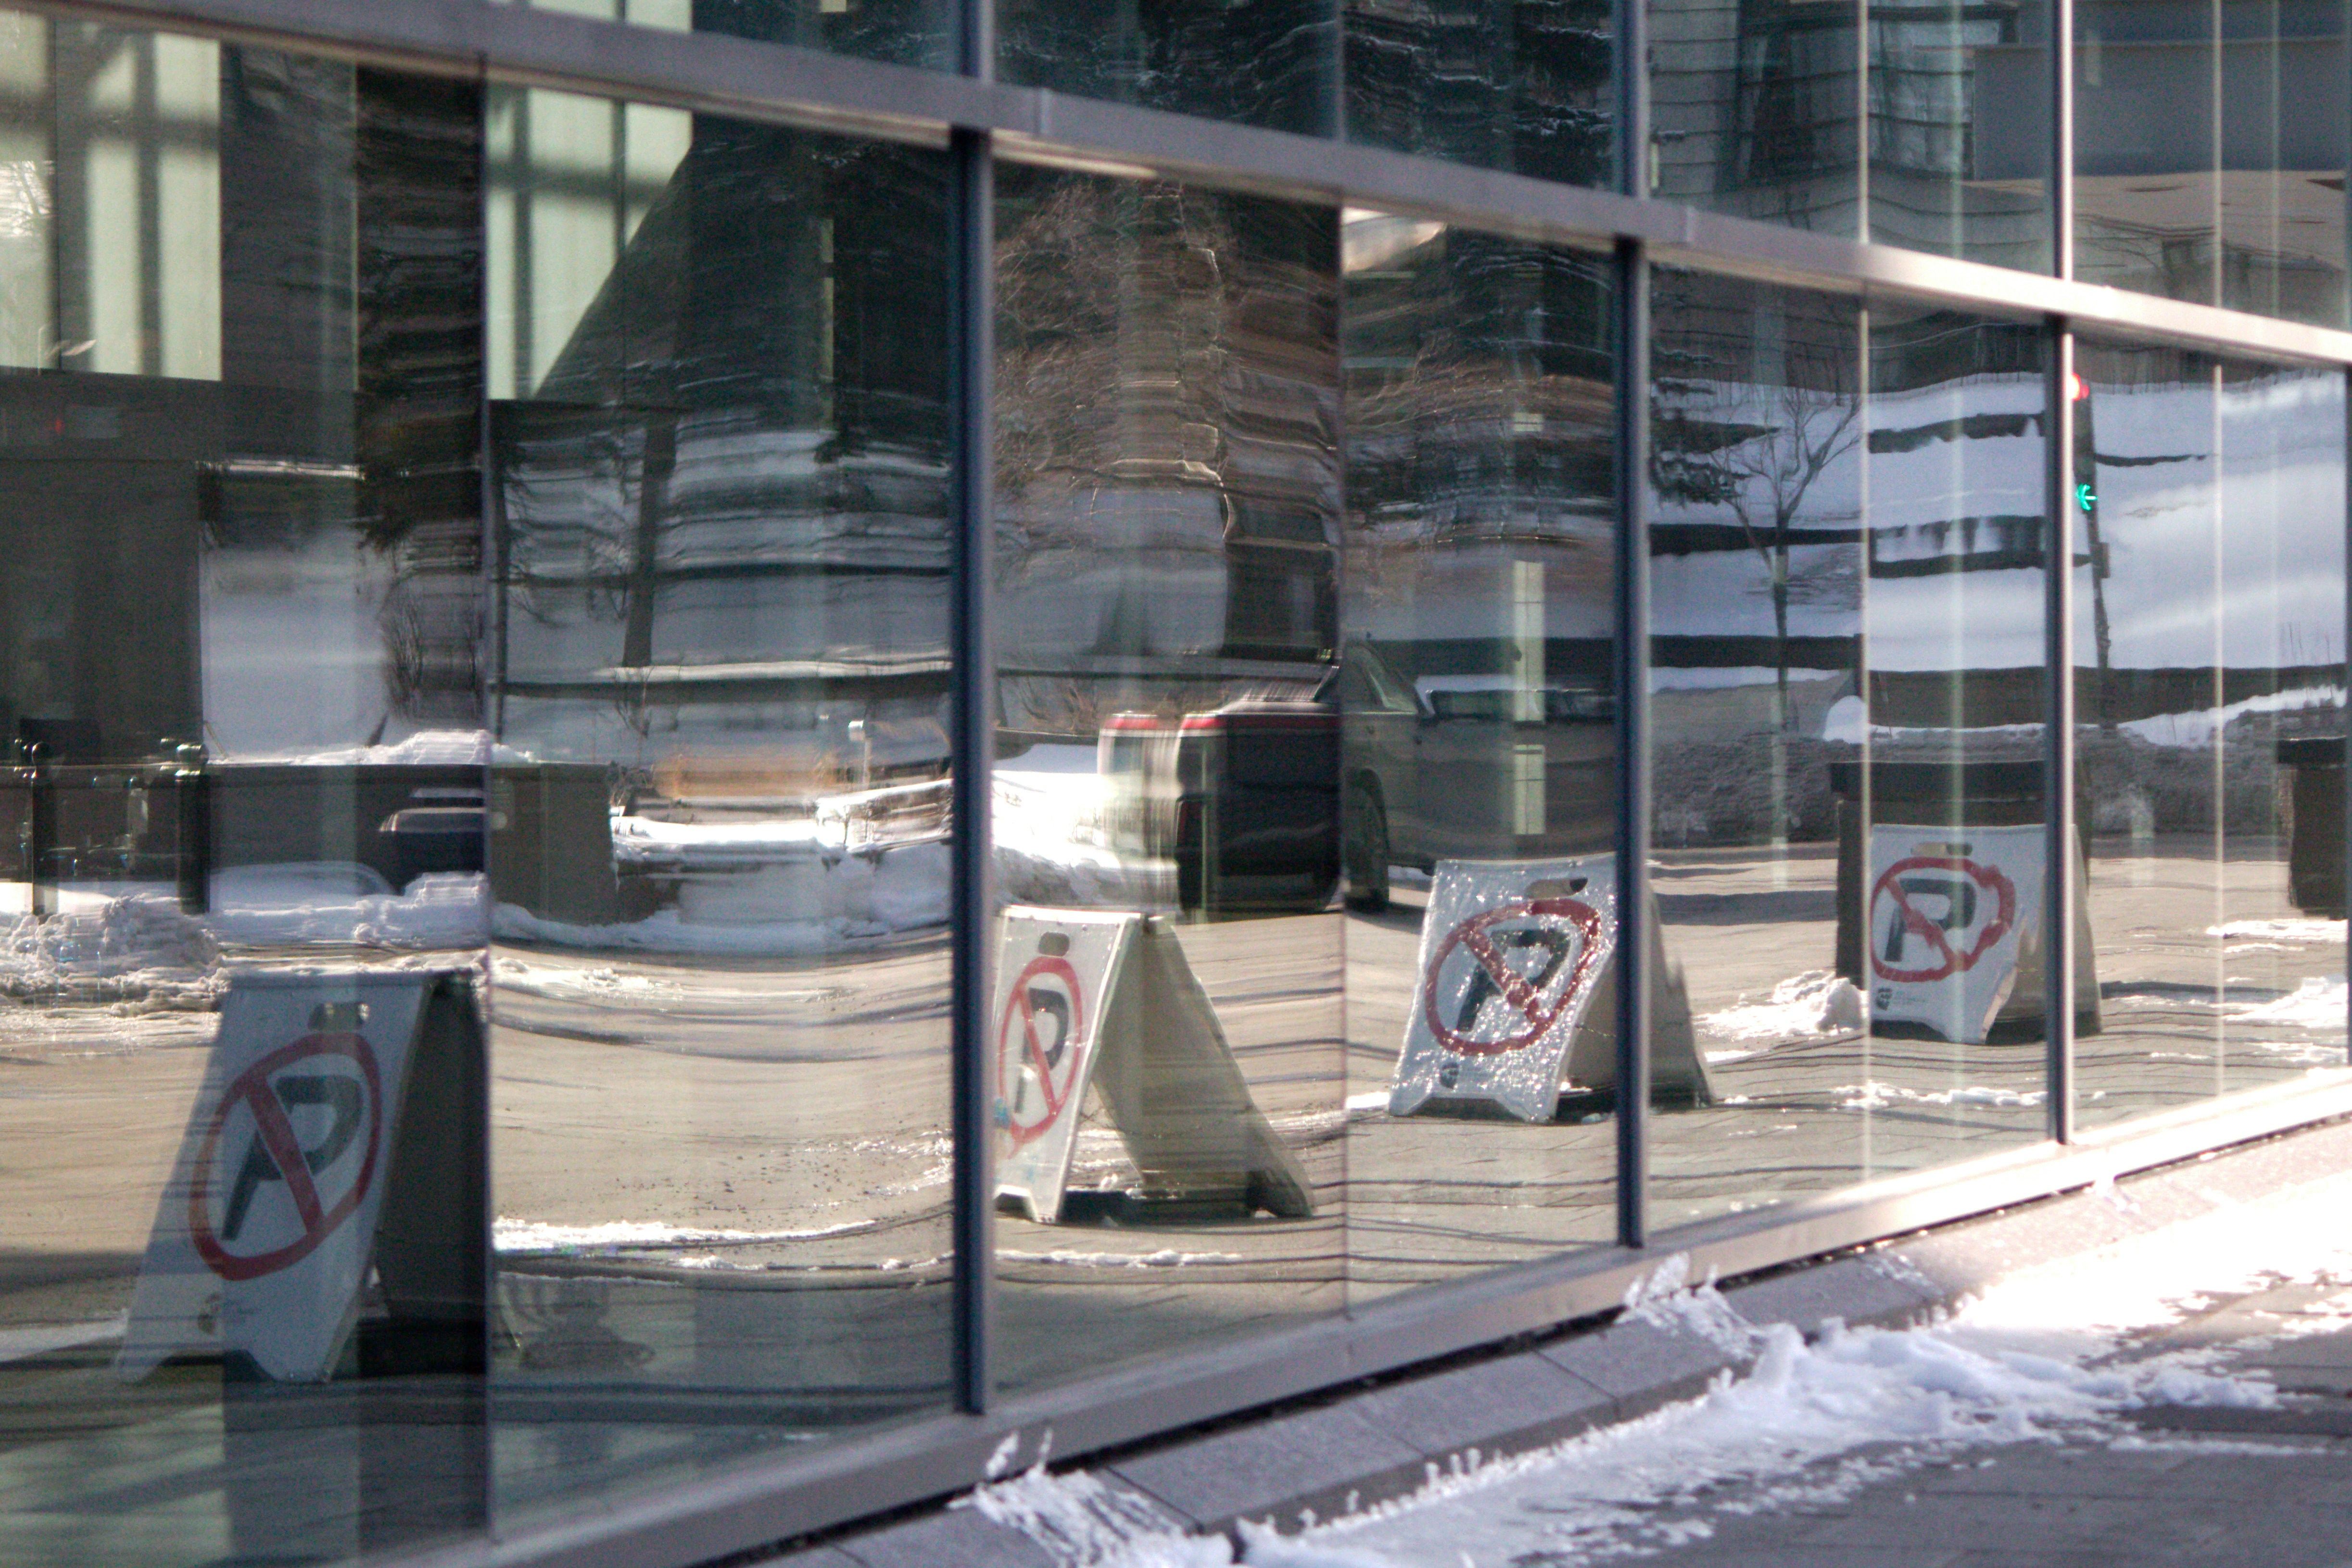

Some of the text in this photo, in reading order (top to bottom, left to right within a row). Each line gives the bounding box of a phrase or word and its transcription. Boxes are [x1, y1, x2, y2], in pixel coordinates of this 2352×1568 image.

[1884, 878, 1976, 962] P
[1456, 928, 1571, 1032] P
[1013, 987, 1068, 1113] P
[221, 1075, 363, 1241] P
